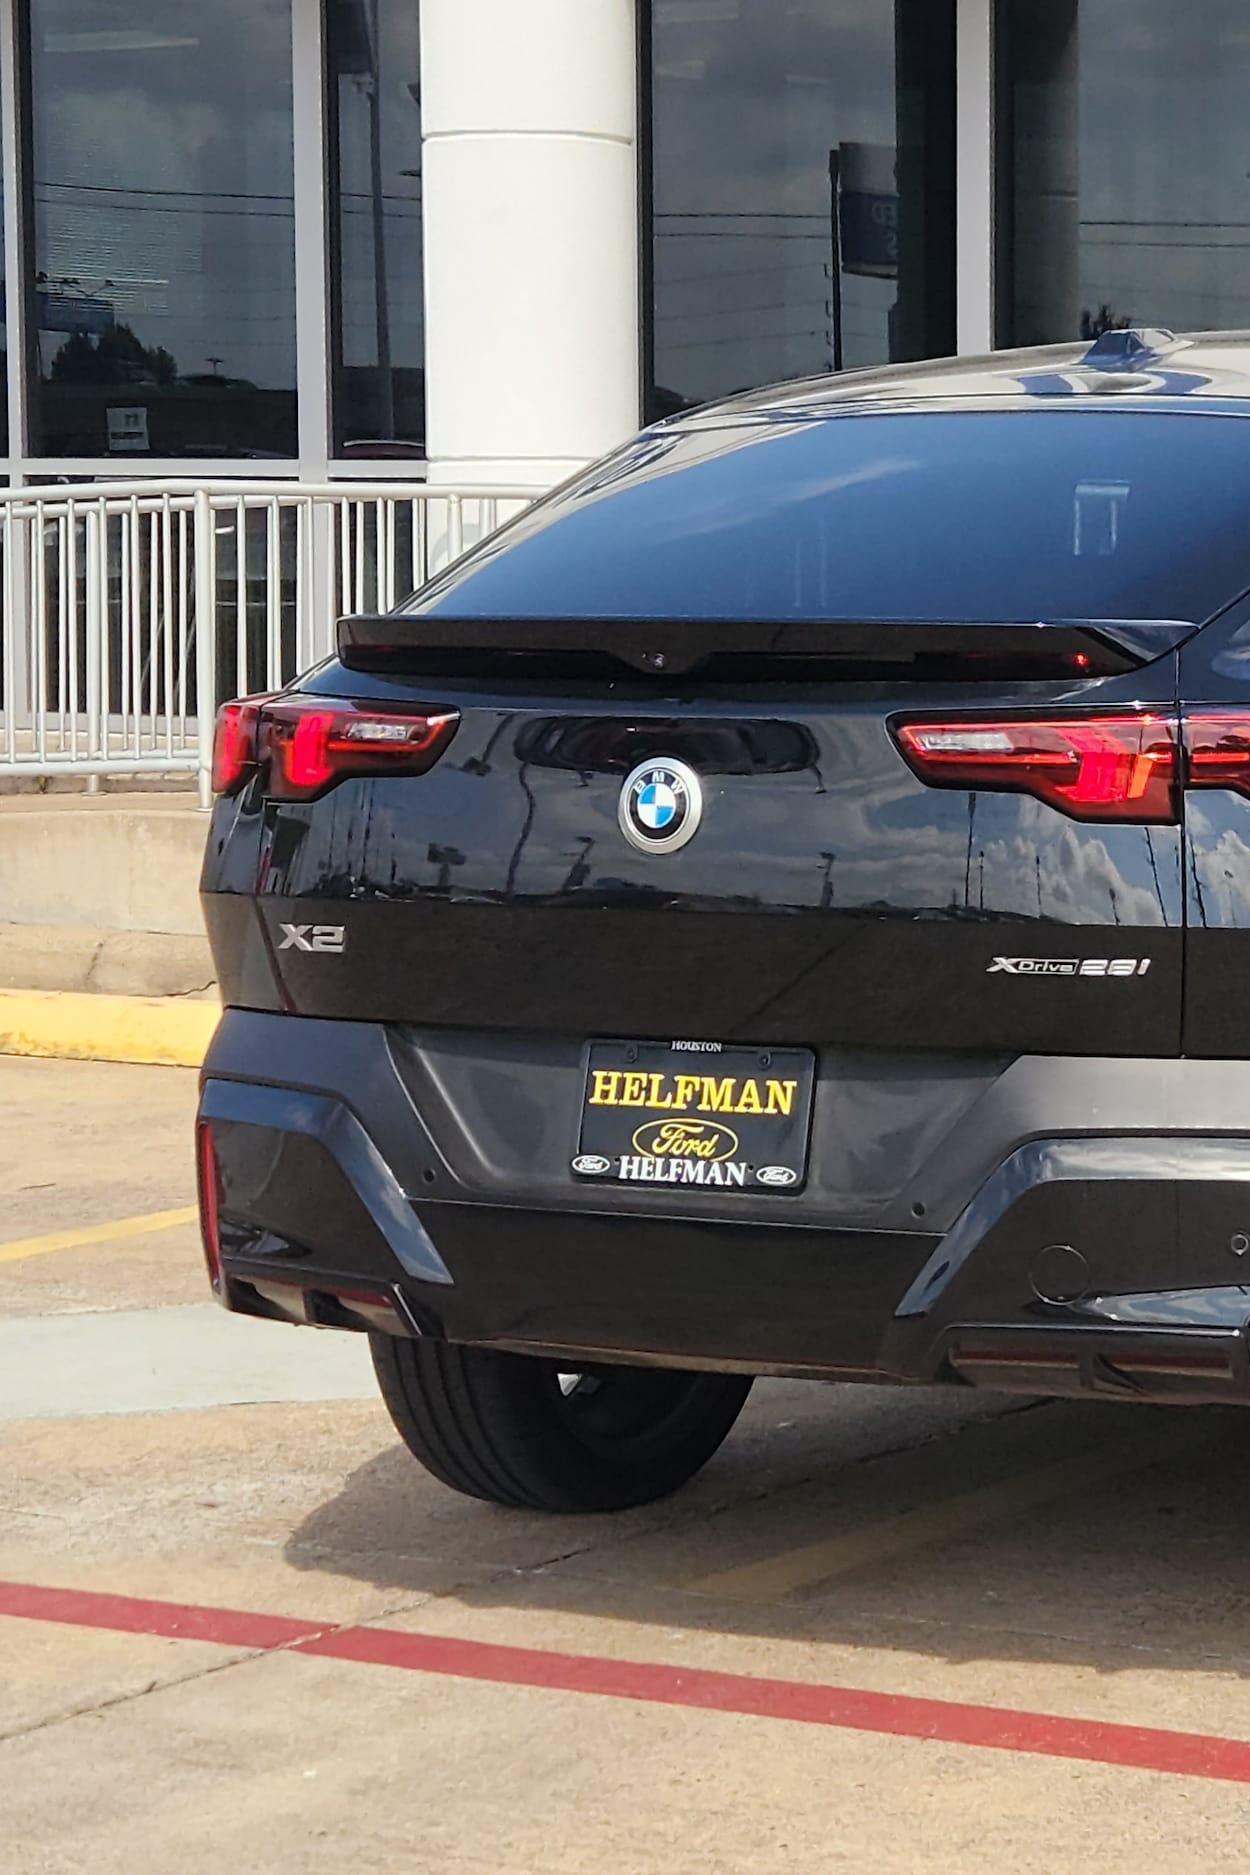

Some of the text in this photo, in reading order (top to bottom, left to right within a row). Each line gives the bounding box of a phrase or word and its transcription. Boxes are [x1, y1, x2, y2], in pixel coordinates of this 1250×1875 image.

[633, 771, 685, 794] BMW
[279, 923, 345, 953] X2
[671, 1040, 722, 1052] HOUSTON
[589, 1070, 797, 1115] HELFMAN
[652, 1124, 719, 1157] Ford
[618, 1155, 747, 1186] HELFMAN
